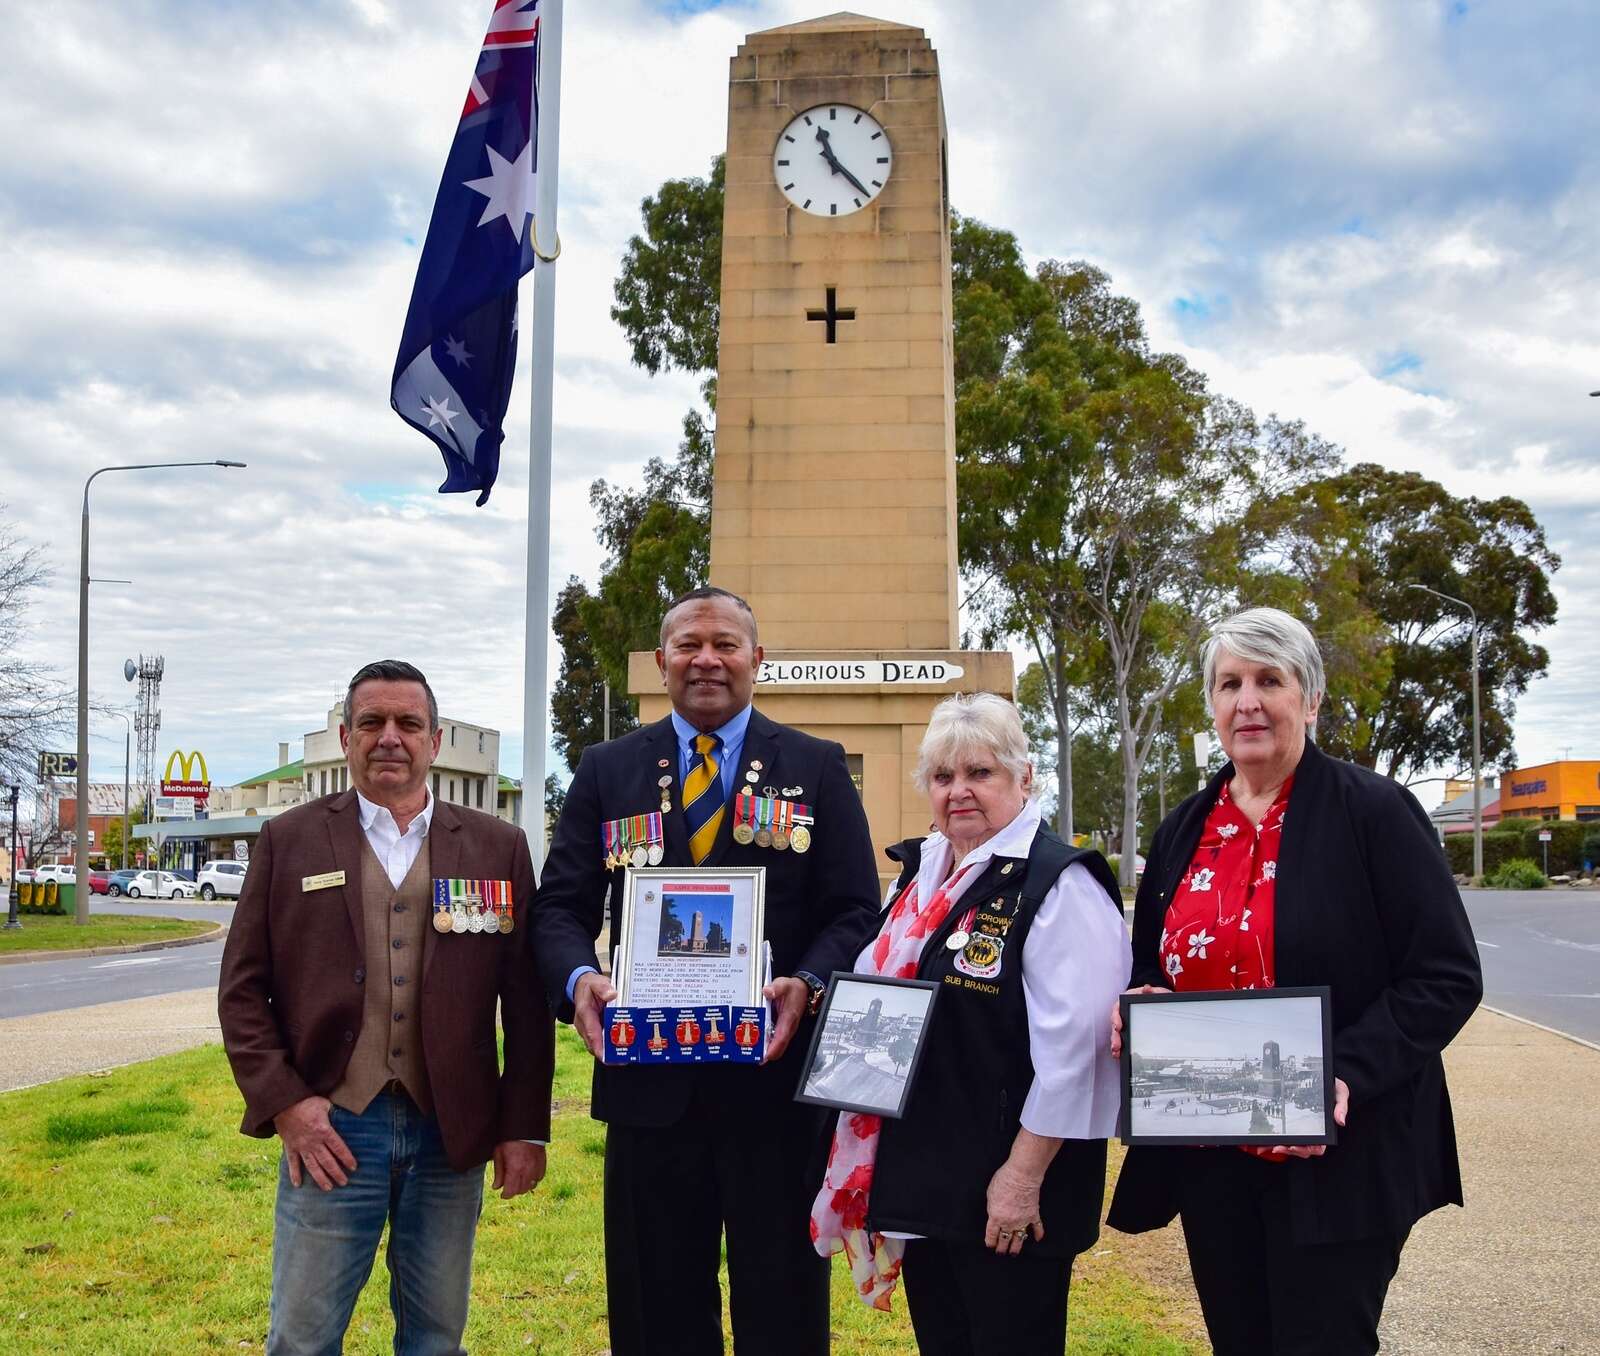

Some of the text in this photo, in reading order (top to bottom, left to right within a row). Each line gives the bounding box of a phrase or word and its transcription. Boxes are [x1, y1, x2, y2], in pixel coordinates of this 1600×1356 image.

[883, 662, 945, 682] DEAD
[164, 785, 209, 793] McDonald's
[945, 975, 1000, 995] SUB BRANCH
